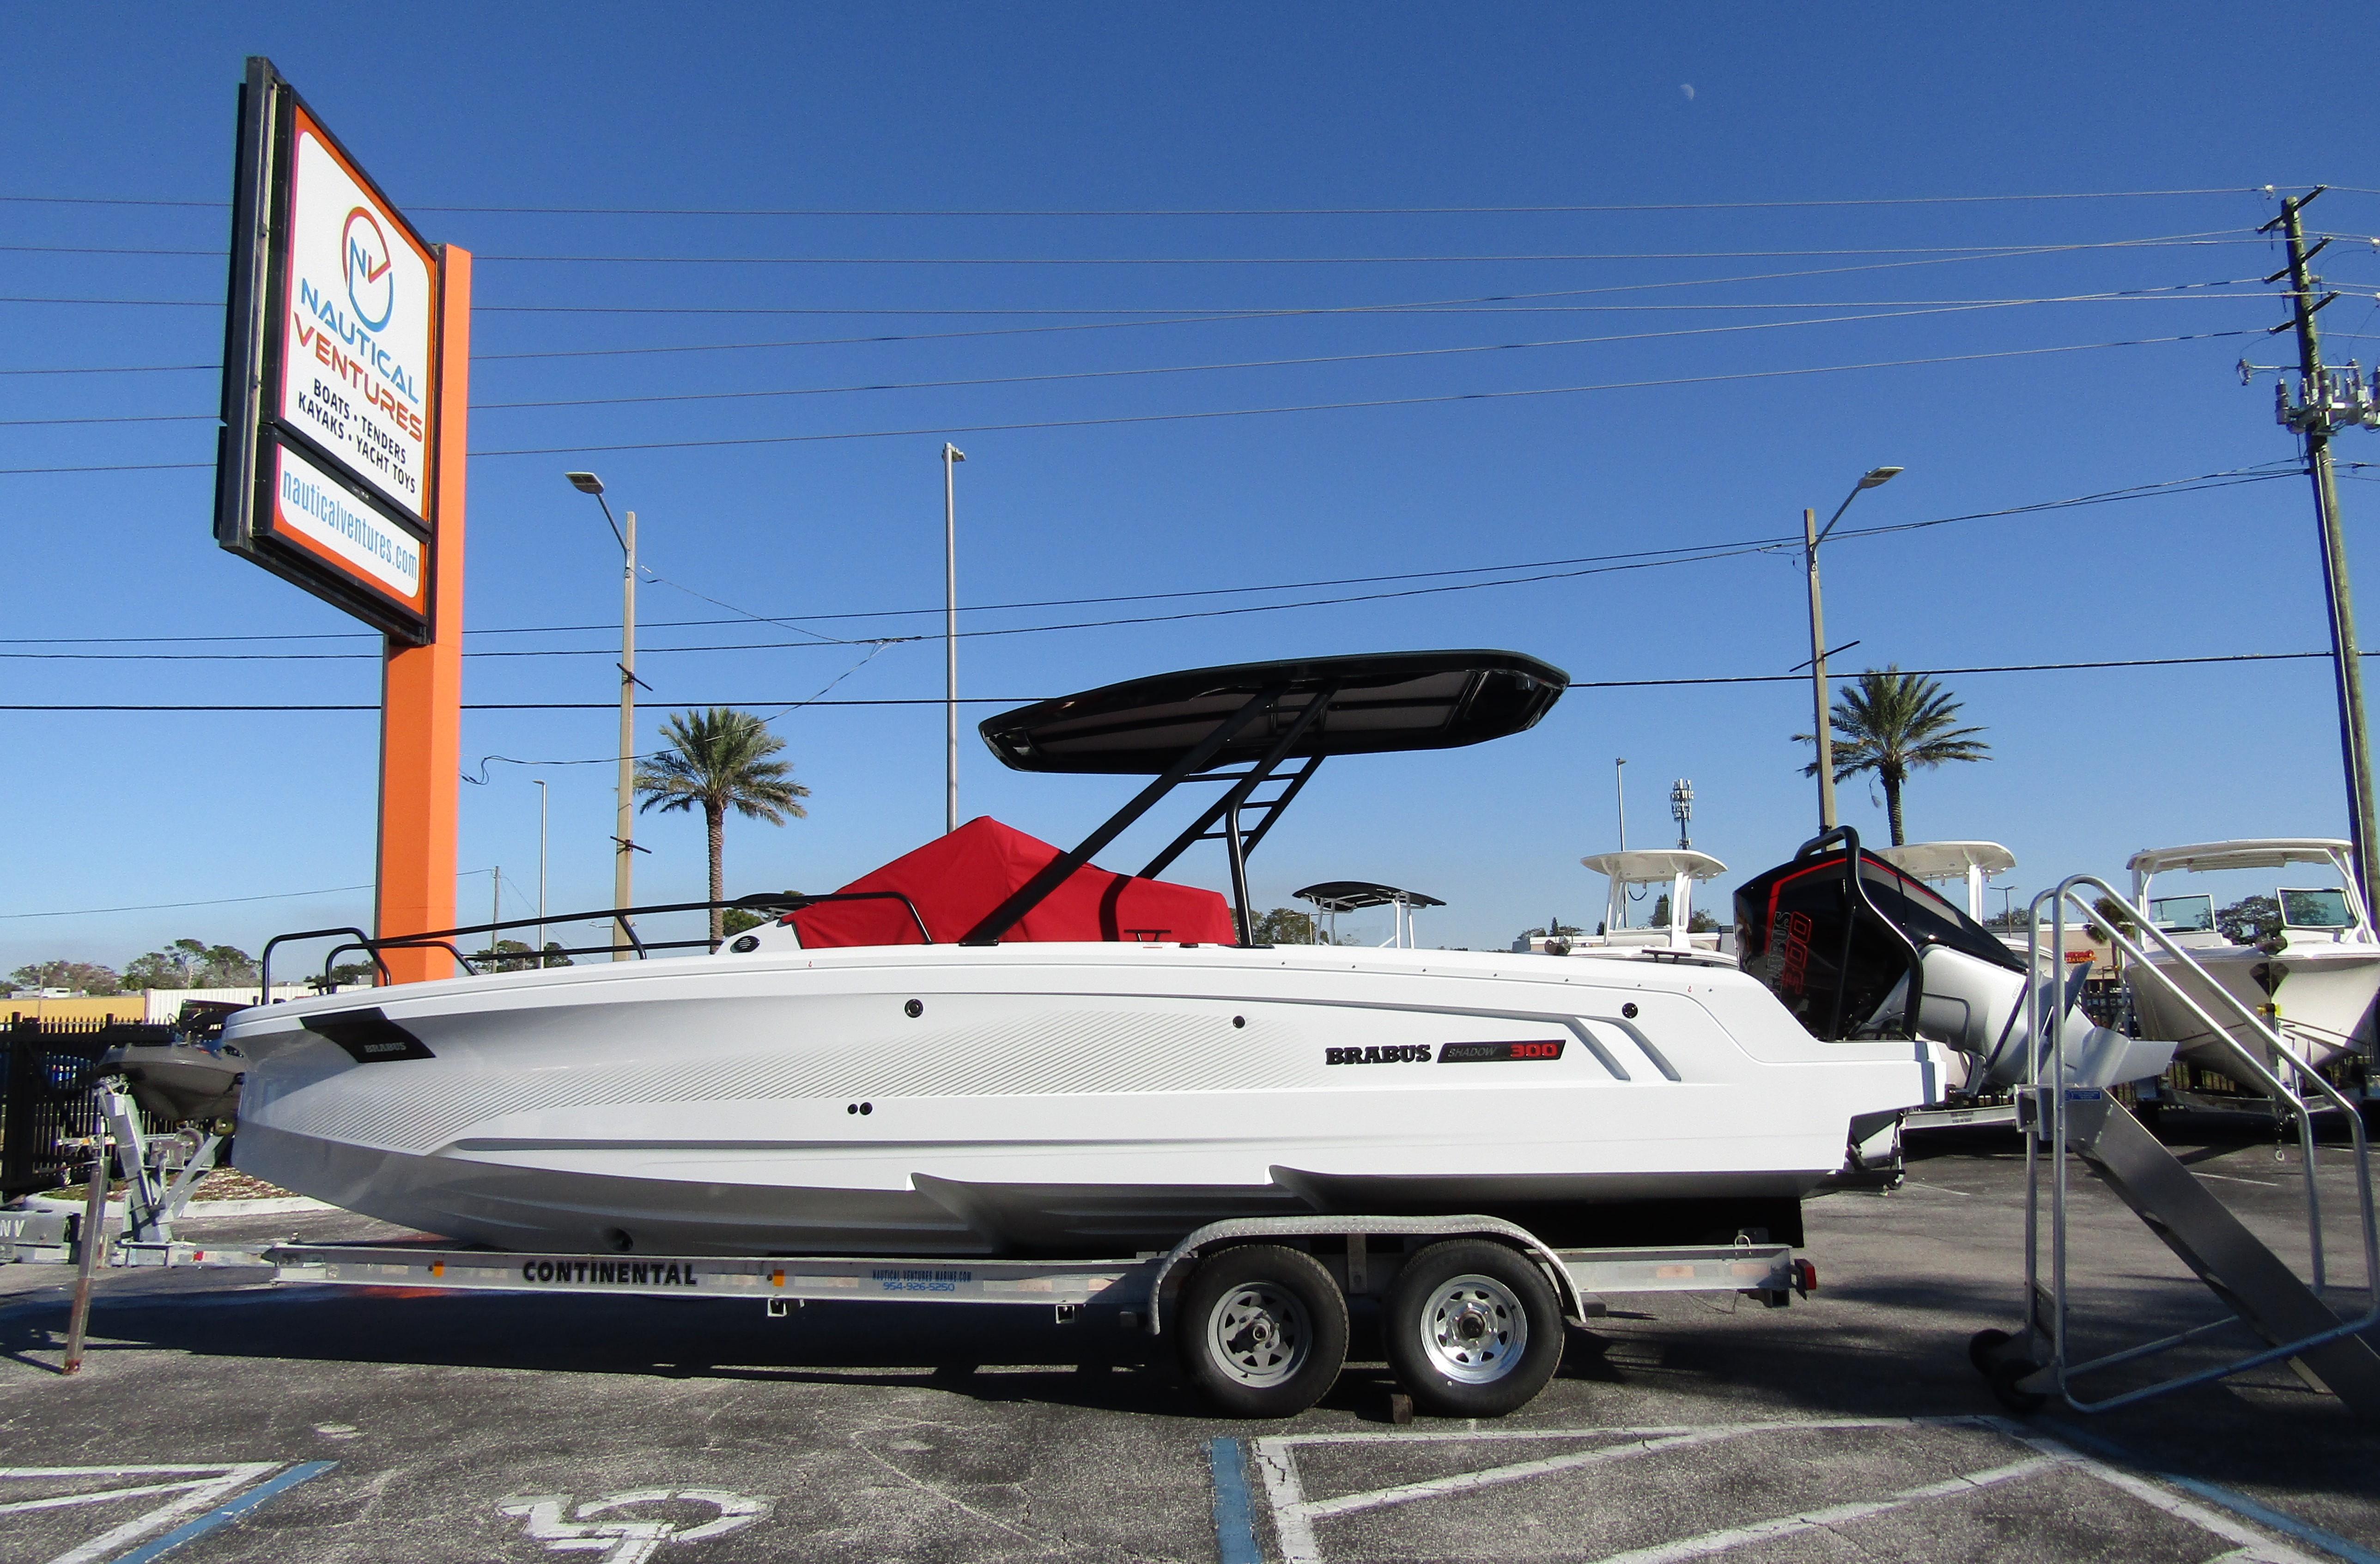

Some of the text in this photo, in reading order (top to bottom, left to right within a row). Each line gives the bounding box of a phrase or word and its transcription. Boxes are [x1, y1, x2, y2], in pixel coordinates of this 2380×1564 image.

[294, 311, 422, 442] VENTURES
[301, 278, 419, 405] NAUTICAL
[298, 390, 415, 494] KAYAKS YACHT TOYS
[314, 377, 406, 464] BOATS TENDERS
[283, 470, 417, 580] nauticalventures.com
[1766, 911, 1791, 993] RABUS
[1782, 911, 1811, 995] 300
[1325, 1043, 1558, 1065] BRABUS SHADOW 300
[522, 1260, 698, 1286] CONTINENTAL
[873, 1269, 971, 1282] NAUTICAL VENTURES MARINE.COM
[883, 1282, 955, 1291] 954-926-5250
